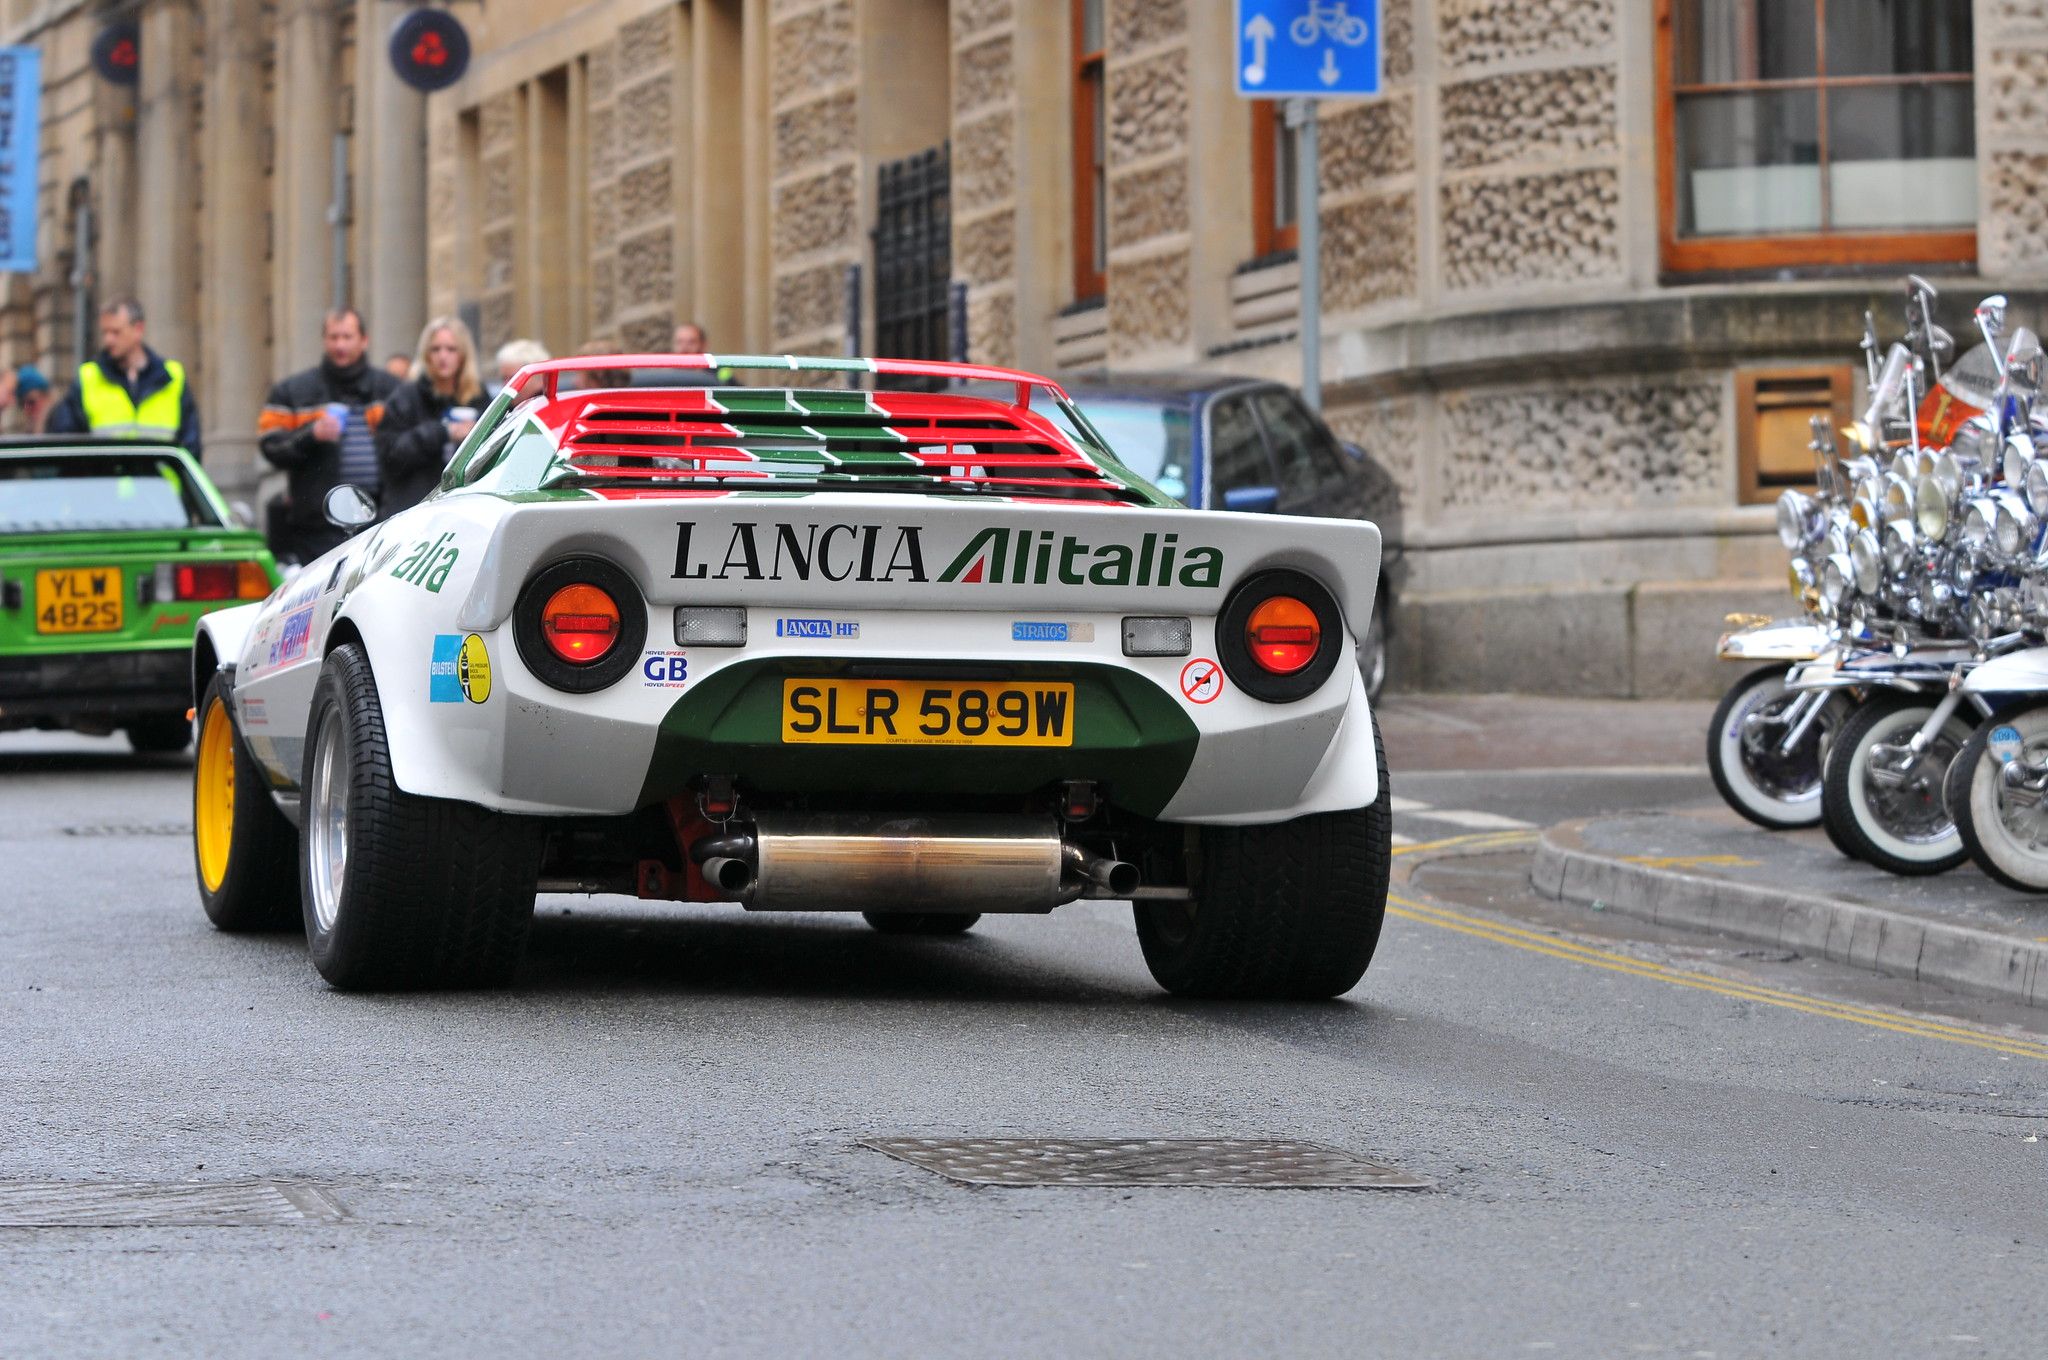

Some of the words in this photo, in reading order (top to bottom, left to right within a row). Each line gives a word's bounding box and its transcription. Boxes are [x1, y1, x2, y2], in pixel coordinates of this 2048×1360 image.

[670, 521, 929, 583] LANCIA
[936, 527, 1224, 588] Alitalia
[50, 572, 107, 598] YLW
[41, 602, 119, 627] 482S
[779, 619, 832, 639] LANCIA
[1013, 623, 1067, 640] STRATOS
[431, 661, 458, 676] BILSTEIN
[643, 656, 688, 681] GB
[789, 686, 900, 735] SLR
[918, 689, 1067, 737] 589W
